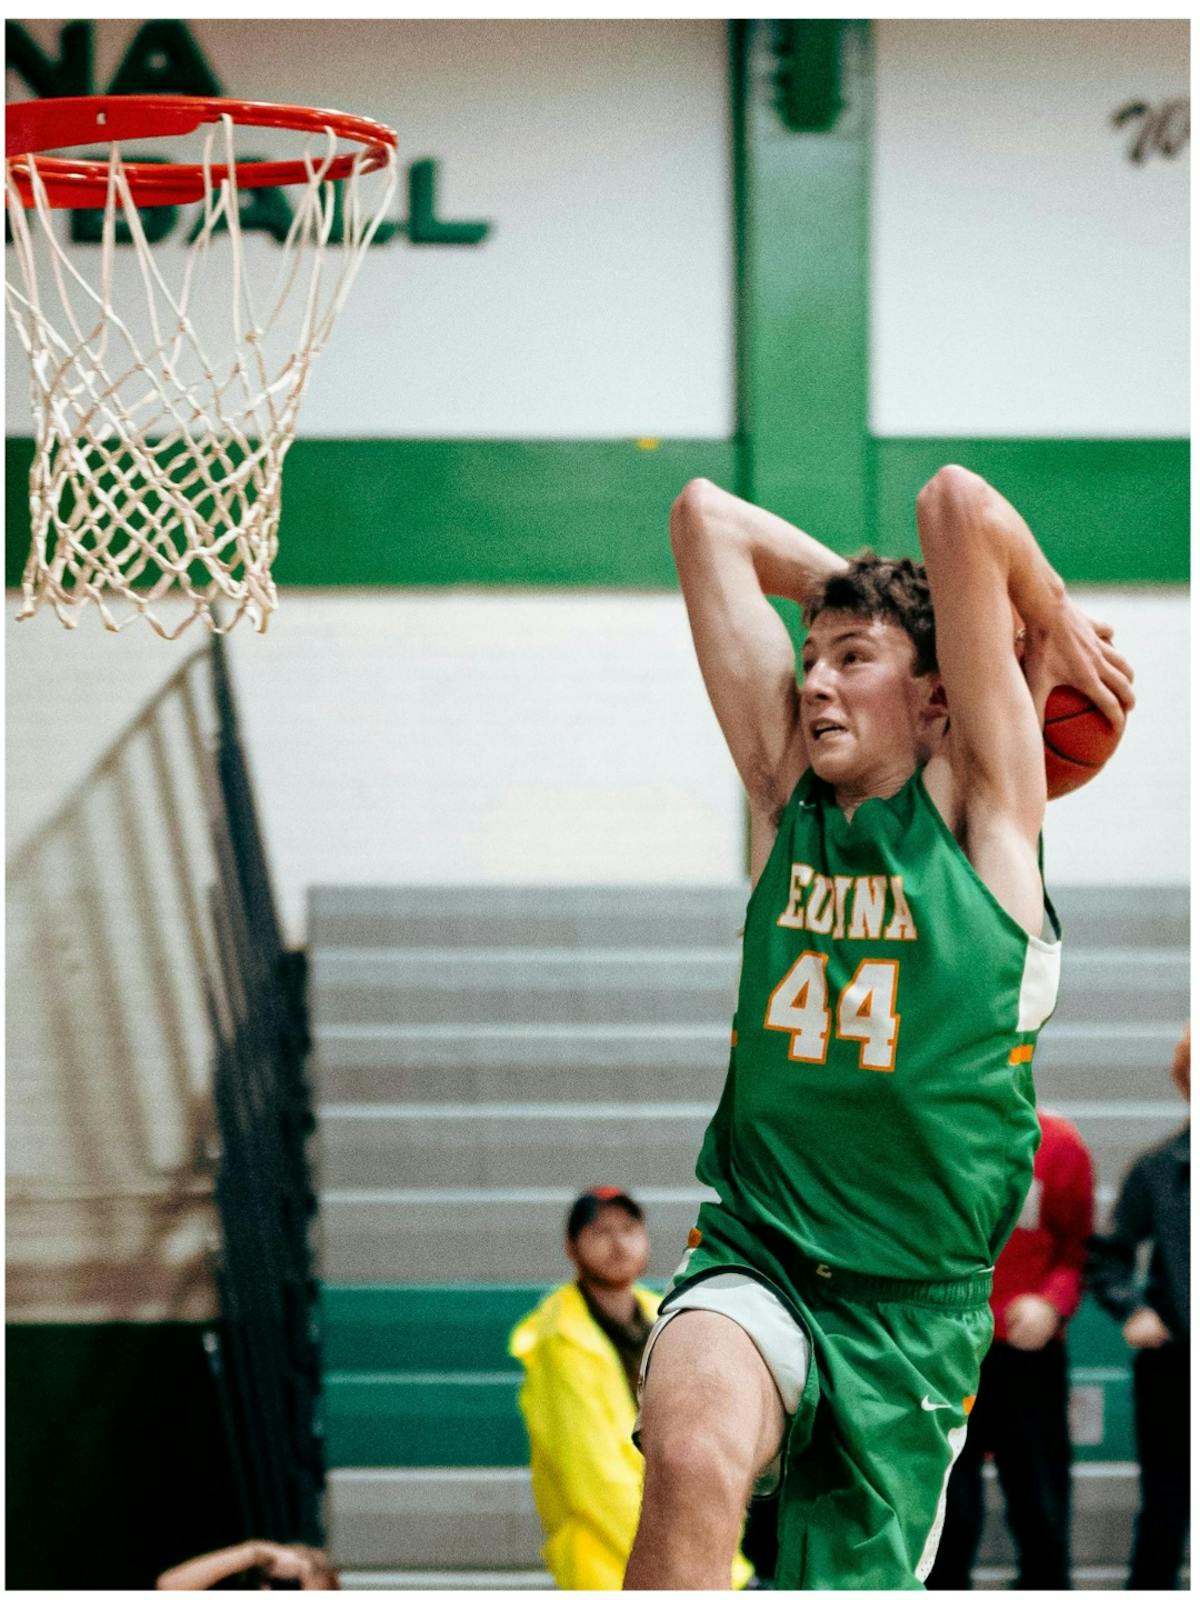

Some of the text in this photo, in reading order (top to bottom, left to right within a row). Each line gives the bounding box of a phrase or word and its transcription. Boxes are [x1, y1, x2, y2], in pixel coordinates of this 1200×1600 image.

[6, 156, 492, 245] BALL
[776, 862, 918, 941] EDINA
[764, 949, 900, 1072] 44
